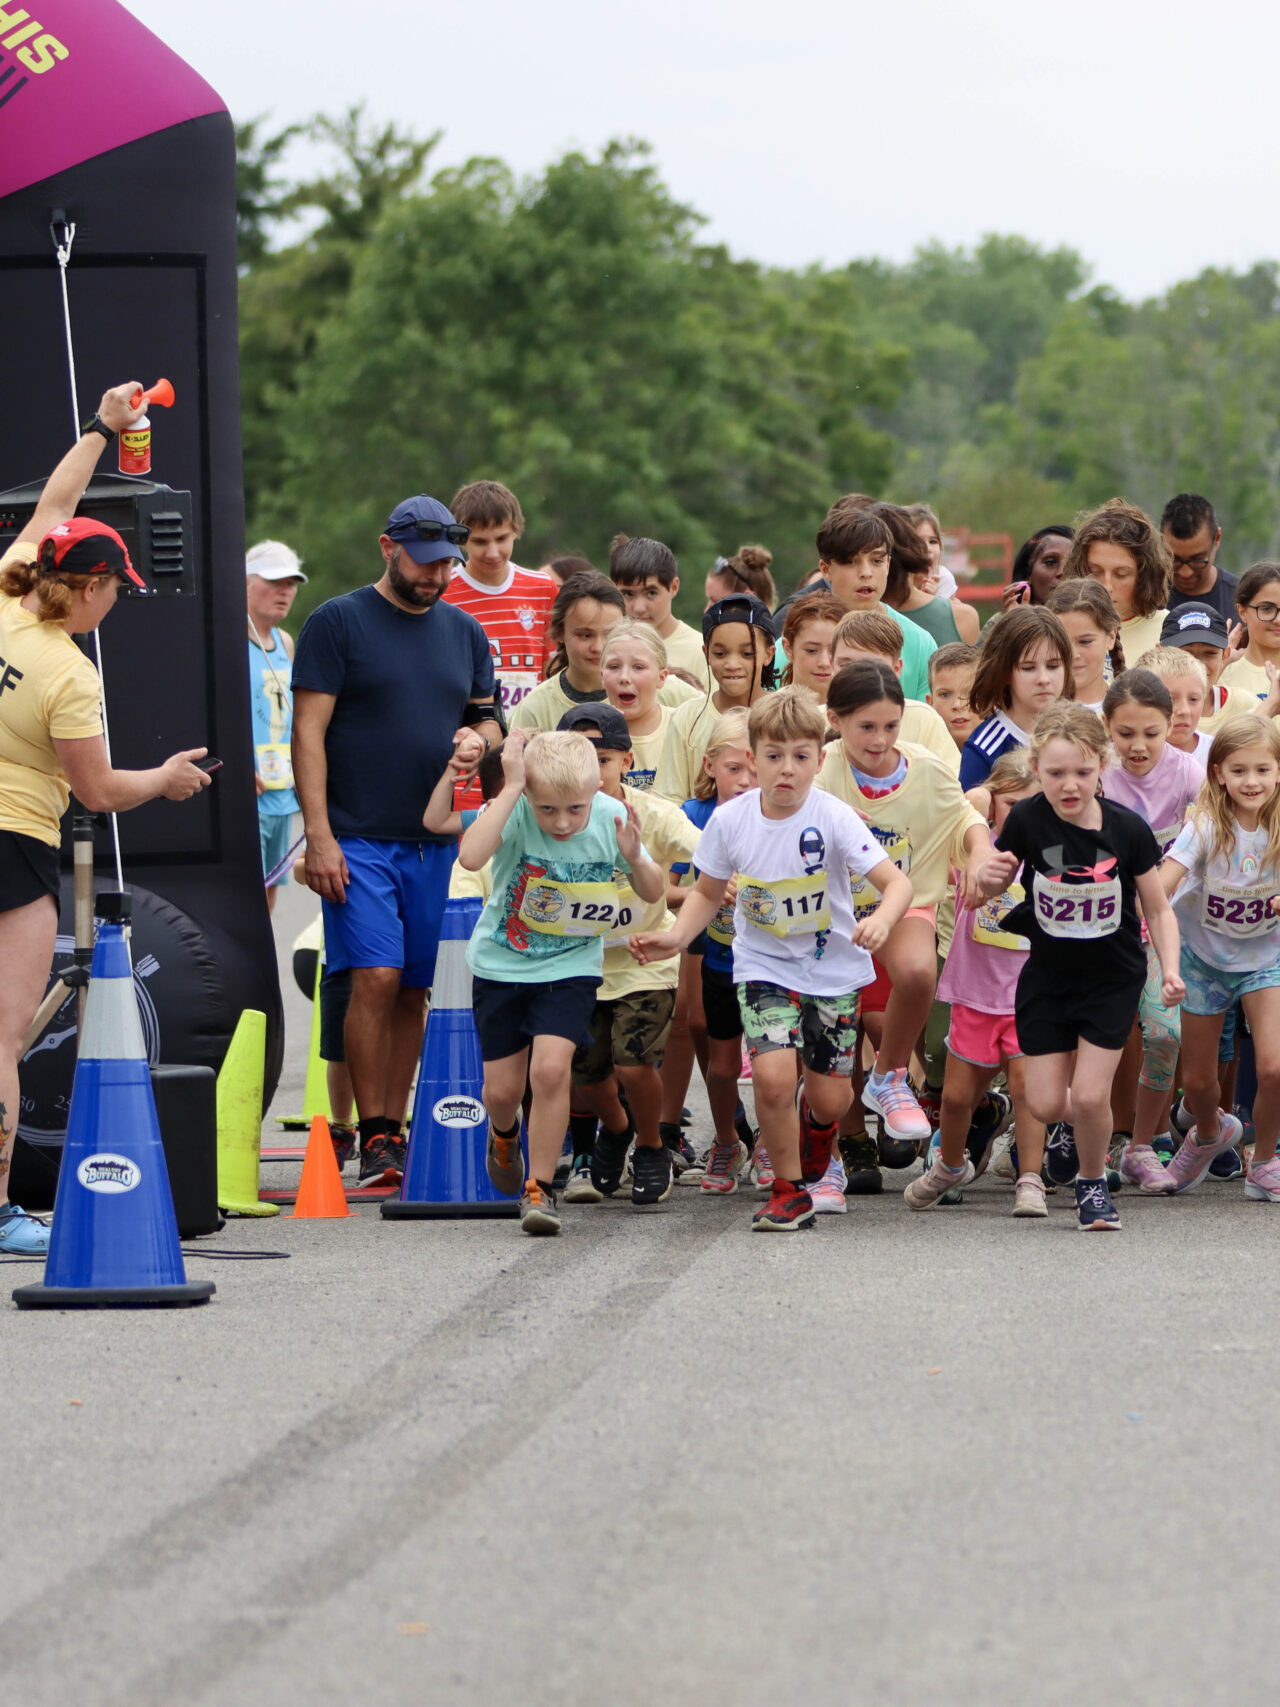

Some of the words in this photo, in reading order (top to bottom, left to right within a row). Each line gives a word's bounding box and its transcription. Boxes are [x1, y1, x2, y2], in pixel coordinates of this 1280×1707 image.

[570, 902, 614, 922] 122
[782, 891, 824, 917] 117
[1038, 891, 1116, 922] 5215
[751, 1016, 784, 1028] Nike
[439, 1107, 480, 1122] BUFFALO
[85, 1167, 133, 1186] BUFFALO
